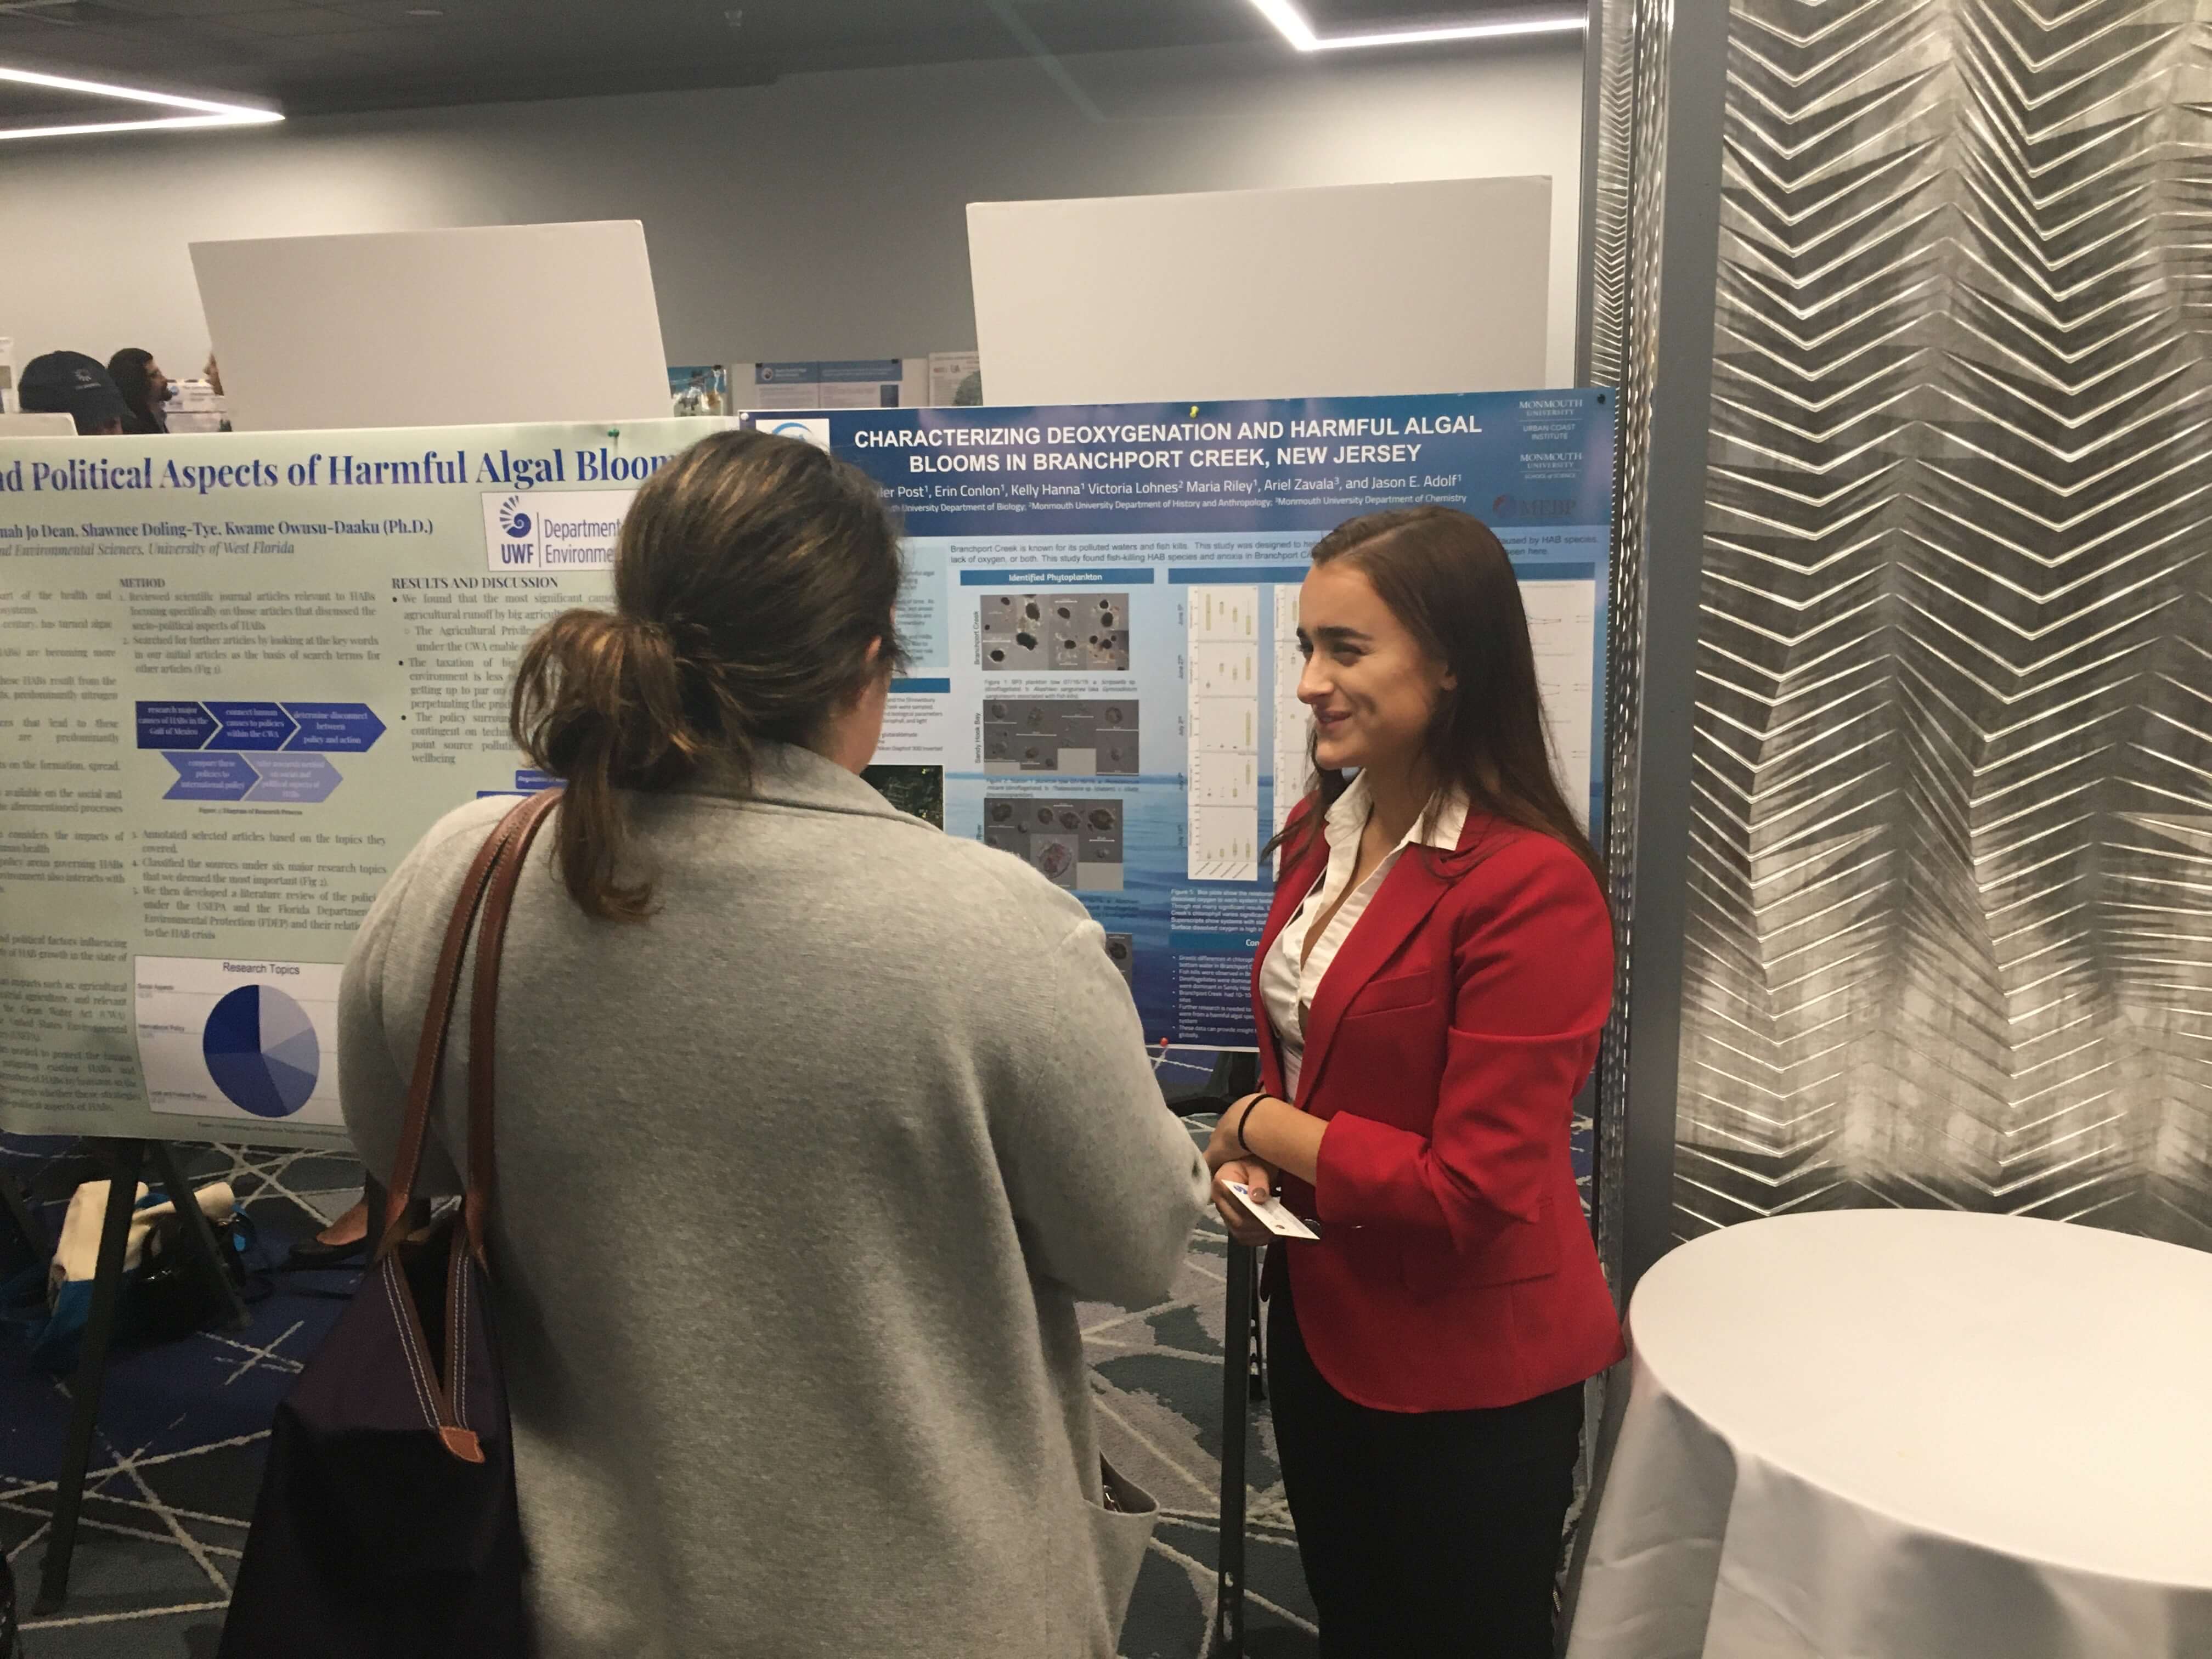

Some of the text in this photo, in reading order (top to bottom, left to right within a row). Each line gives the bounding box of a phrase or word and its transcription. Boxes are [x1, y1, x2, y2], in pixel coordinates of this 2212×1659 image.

[1519, 399, 1582, 409] MONMOUTH
[855, 415, 1482, 447] CHARACTERIZING DEOXYGENATION AND HARMFUL ALGAL
[910, 444, 1421, 472] BLOOMS IN BRANCHPORT CREEK, NEW JERSEY
[1520, 453, 1582, 461] MONMOUTH
[31, 457, 152, 491] Political
[160, 459, 278, 494] Aspects
[288, 453, 321, 486] of
[329, 450, 468, 485] Harmful
[476, 448, 565, 489] Algal
[935, 486, 957, 497] Erin
[1011, 484, 1040, 498] Kelly
[1088, 483, 1132, 495] Victoria
[1187, 482, 1220, 492] Maria
[1264, 478, 1290, 490] Ariel
[1346, 477, 1368, 489] and
[1372, 477, 1406, 489] Jason
[1409, 476, 1419, 488] E.
[902, 504, 939, 512] University
[941, 504, 986, 512] Department
[1076, 501, 1113, 510] University
[1115, 500, 1160, 510] Department
[1172, 500, 1199, 509] History
[1323, 496, 1363, 505] University
[1365, 495, 1413, 505] Department
[1426, 495, 1466, 504] Chemistry
[26, 525, 38, 540] Jo
[82, 523, 138, 538] Shawnee
[225, 522, 274, 535] Kwame
[278, 520, 379, 535] Owusu-Daaku
[383, 518, 433, 535] (Ph.D.)
[545, 519, 621, 540] Department
[1529, 537, 1538, 545] by
[14, 543, 94, 556] Environmental
[149, 541, 205, 556] University
[208, 541, 221, 557] of
[224, 541, 249, 554] West
[253, 541, 294, 554] Florida
[501, 544, 534, 563] UWF
[951, 545, 992, 554] Branchport
[1079, 543, 1109, 552] polluted
[1214, 541, 1233, 551] study
[1255, 541, 1291, 550] designed
[1060, 554, 1080, 563] study
[1107, 553, 1145, 563] fish-killing
[1168, 553, 1198, 561] species
[1255, 551, 1299, 560] Branchport
[119, 579, 165, 588] METHOD
[392, 577, 558, 589] RESULTS AND DISCUSSION
[1009, 573, 1102, 583] Identified Phytoplankton
[403, 592, 582, 603] We found that the most significant
[404, 608, 523, 620] agricultural runoff by big
[415, 625, 495, 636] The Agricultural
[417, 643, 445, 652] under
[448, 642, 462, 651] the
[489, 642, 518, 652] enable
[412, 753, 455, 765] wellbeing
[142, 830, 264, 842] Annotated selected articles
[223, 962, 300, 975] Research Topics
